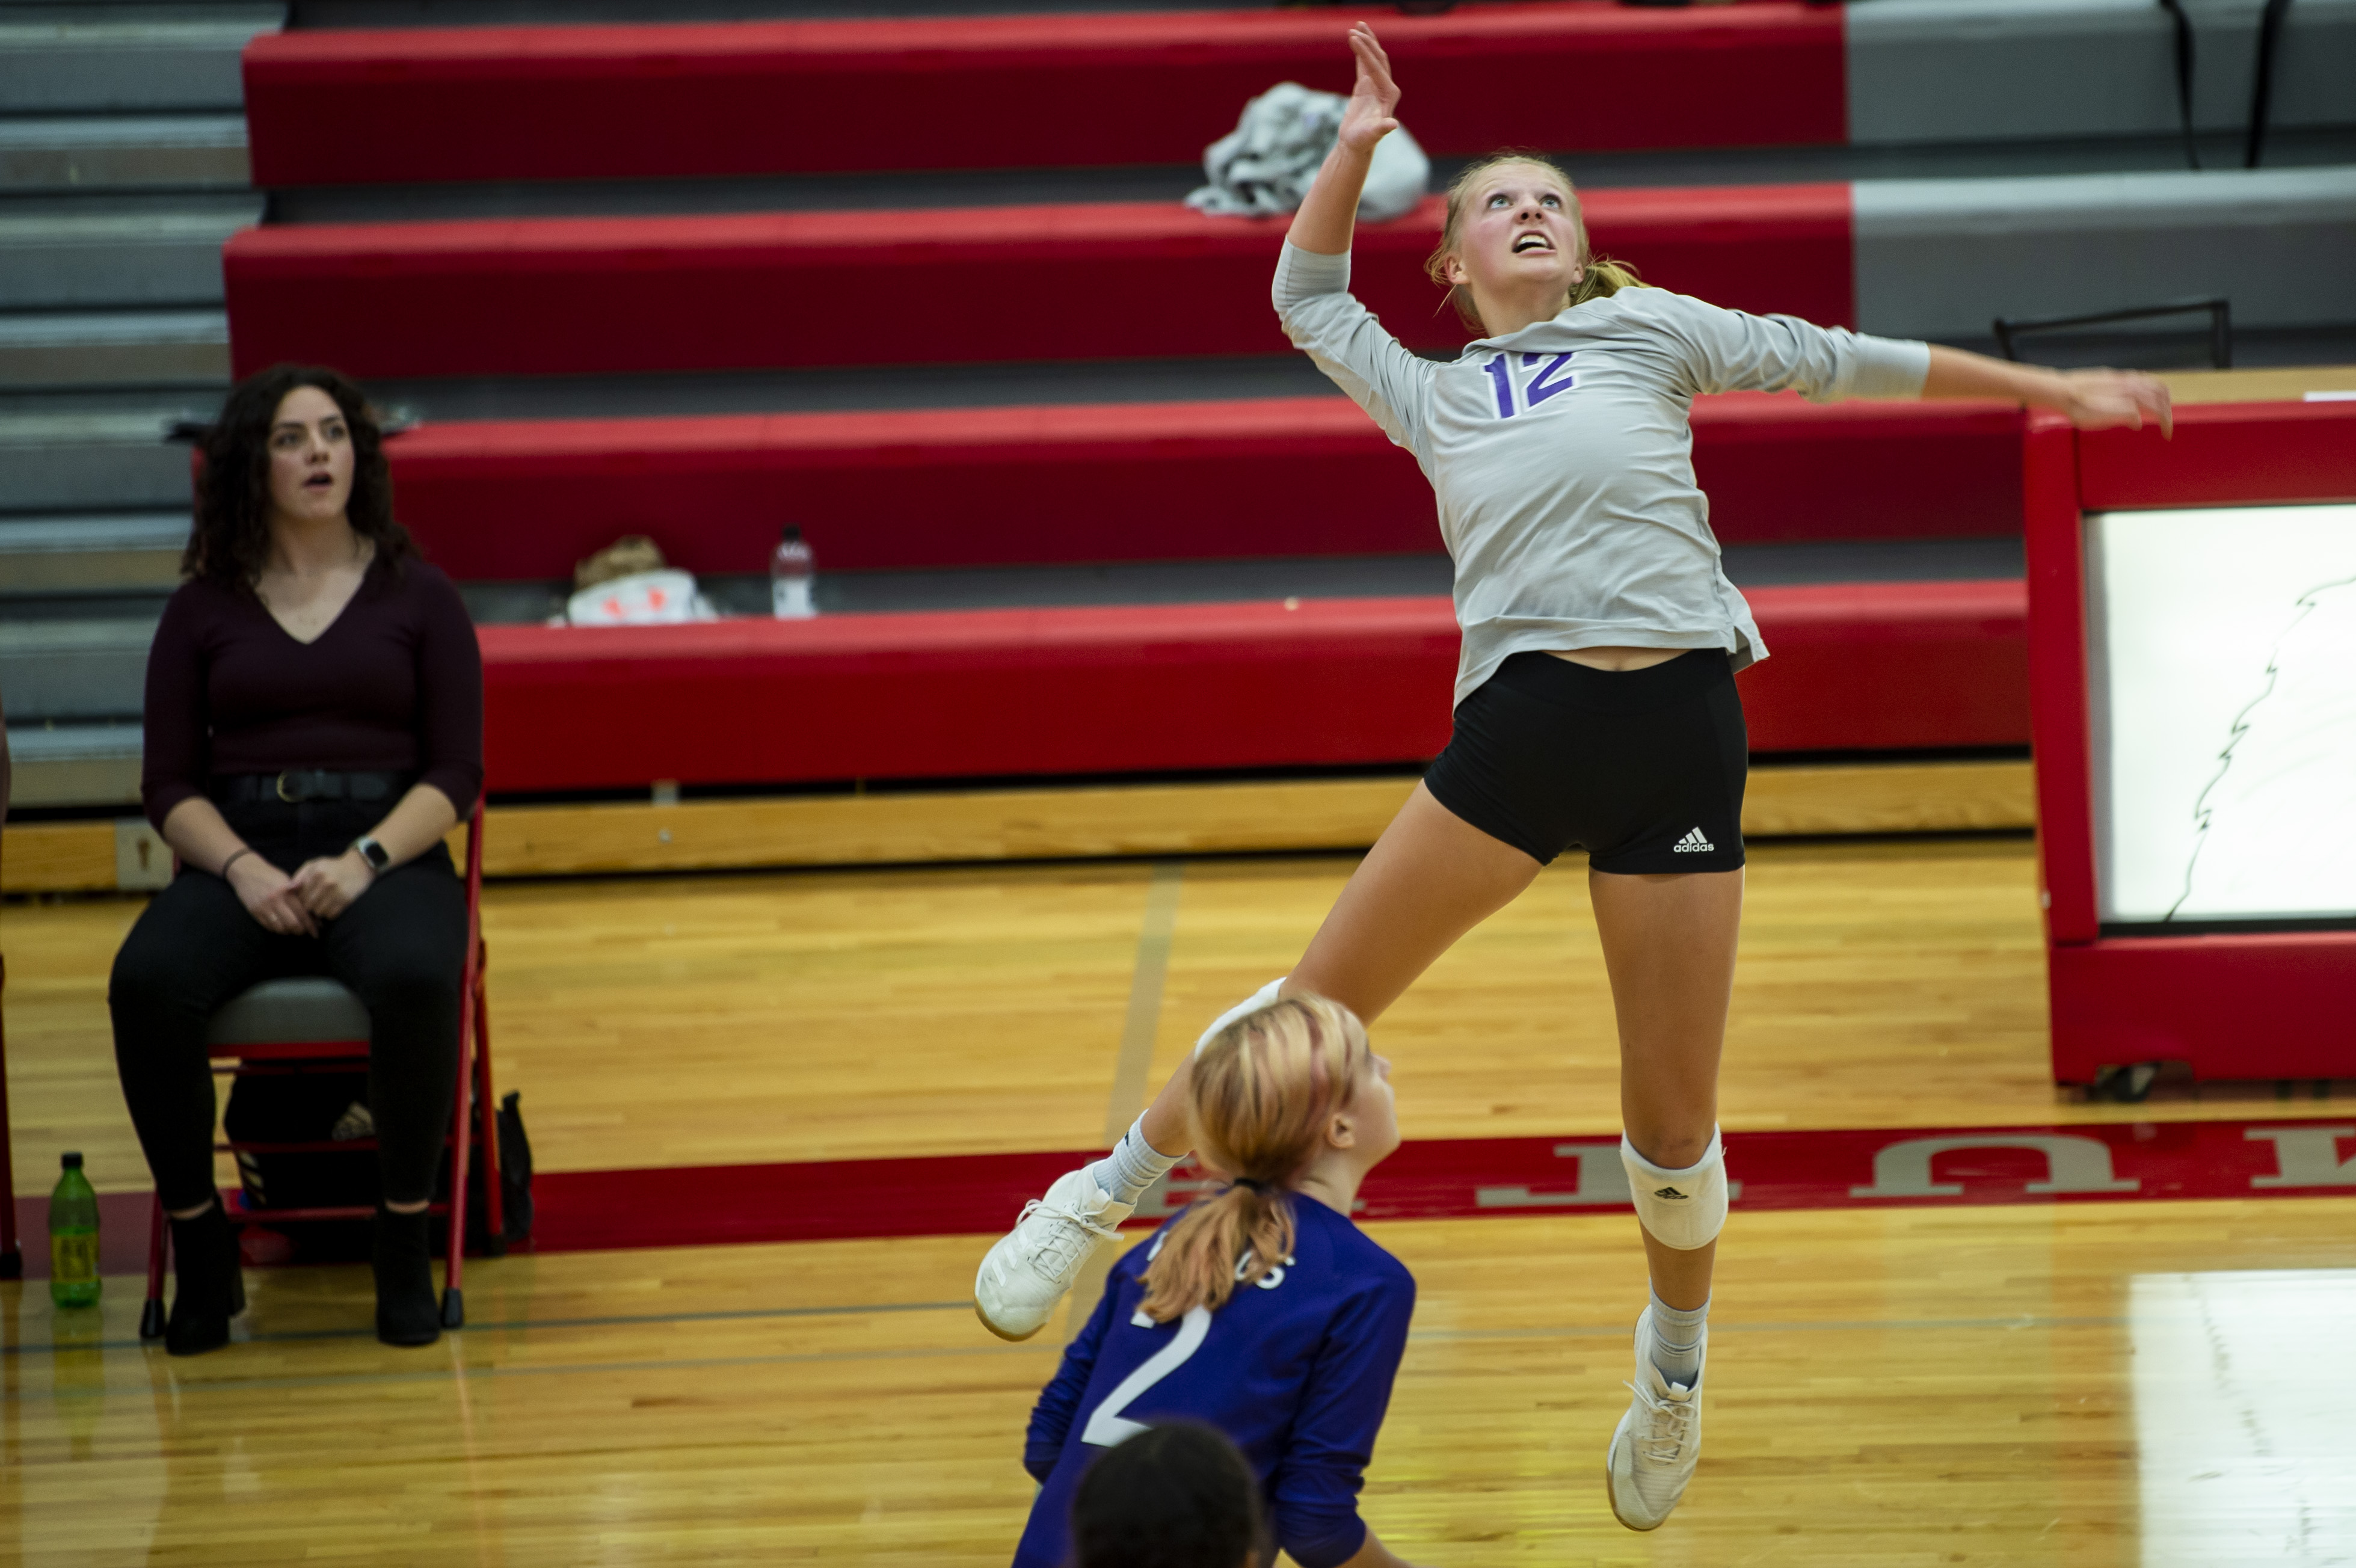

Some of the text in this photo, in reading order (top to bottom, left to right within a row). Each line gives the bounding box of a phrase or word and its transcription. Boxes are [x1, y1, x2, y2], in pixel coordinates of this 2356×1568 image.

[1481, 351, 1576, 419] 12
[1673, 843, 1714, 852] adidas
[1081, 1303, 1212, 1448] 2
